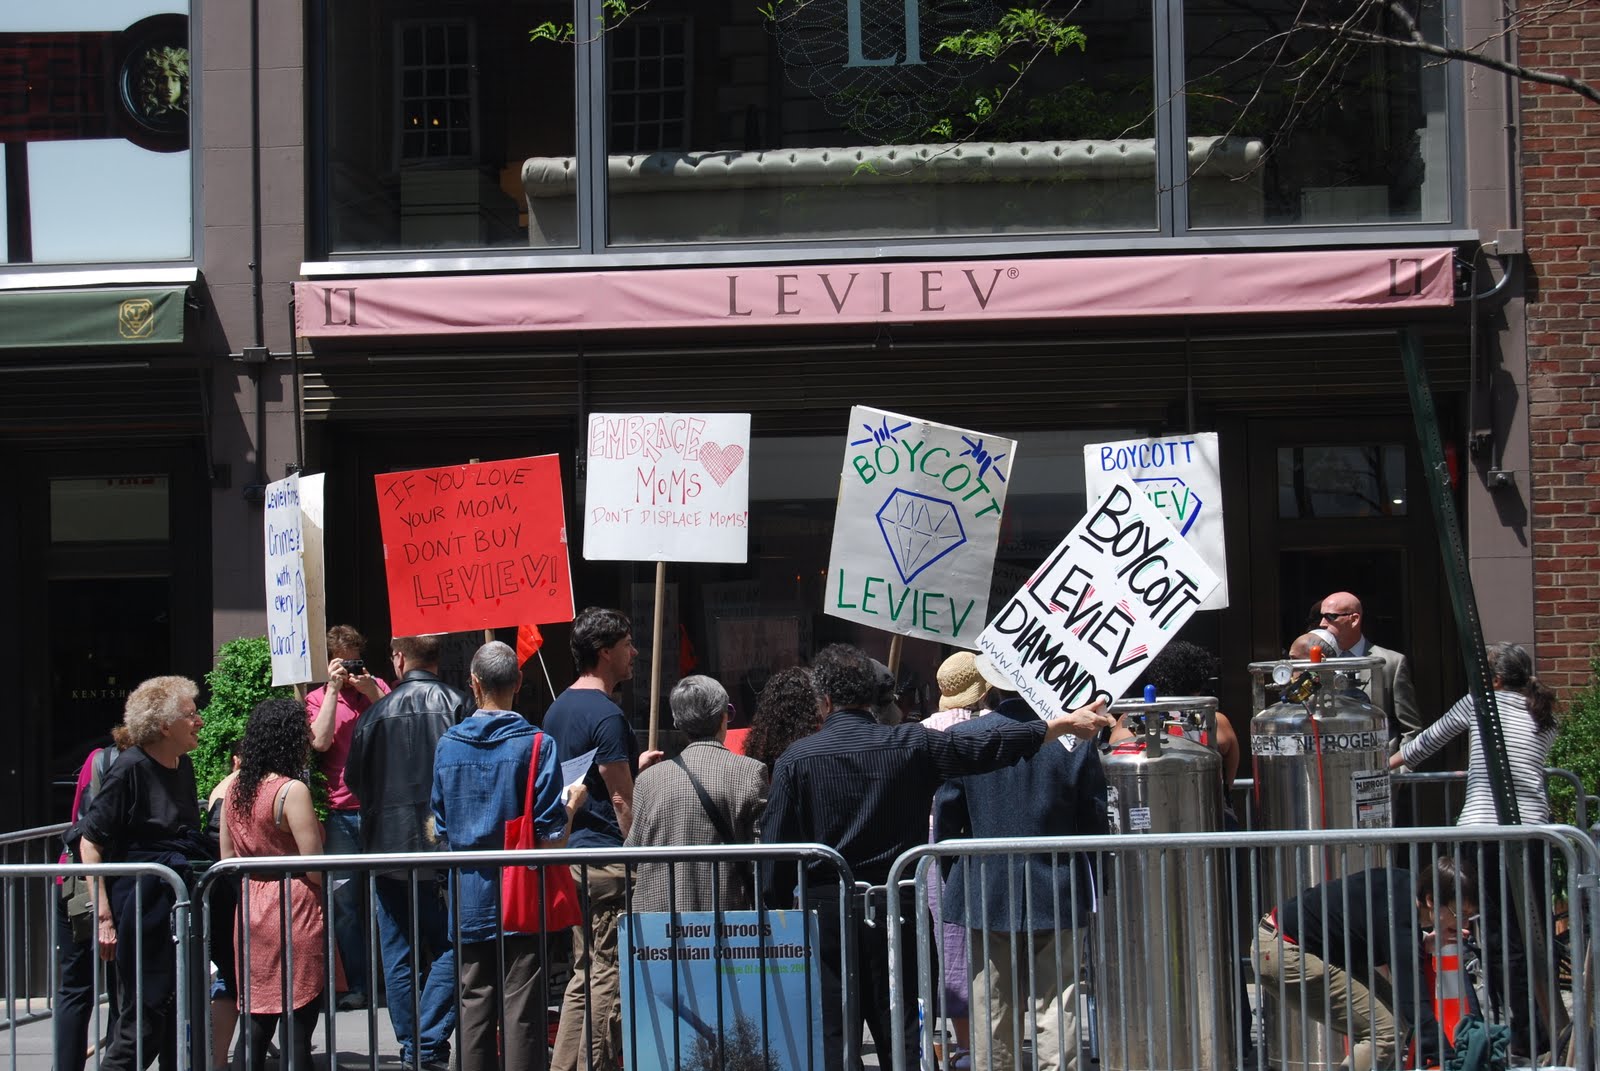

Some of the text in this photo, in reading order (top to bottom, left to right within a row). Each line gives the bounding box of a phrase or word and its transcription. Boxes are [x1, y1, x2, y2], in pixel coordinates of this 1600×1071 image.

[590, 416, 706, 463] EMBRACE
[1101, 440, 1195, 471] BOYCOTT
[384, 468, 533, 510] IF YOU LOVE
[853, 440, 1001, 518] BOYCOTT
[400, 493, 518, 537] YOUR MOM,
[592, 507, 633, 525] DON'T
[641, 509, 702, 527] DISPLACE
[403, 523, 522, 564] DON'T BUY
[1085, 484, 1202, 630] BOYCOTT
[276, 565, 291, 587] with
[413, 554, 558, 608] LEVIEV!
[275, 594, 293, 623] every
[837, 569, 975, 638] LEVIEV
[1028, 545, 1149, 675] LEVIEV
[271, 624, 296, 656] Carat
